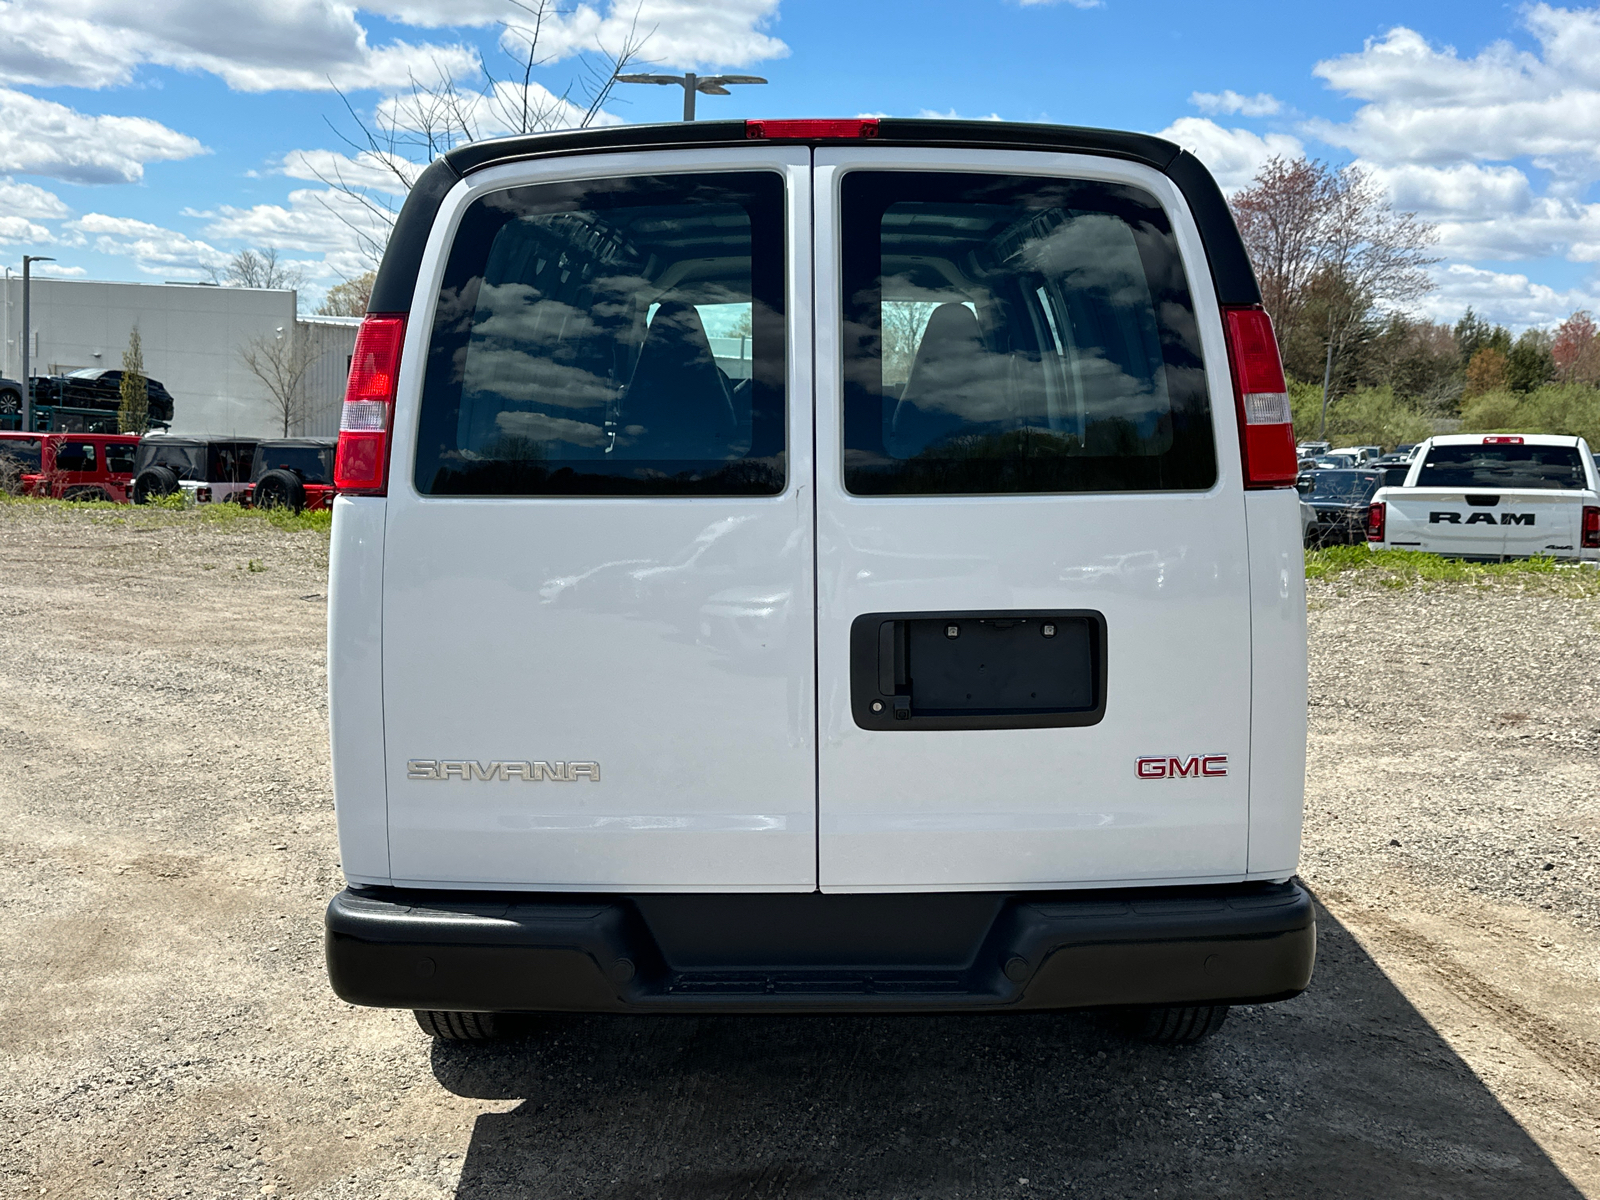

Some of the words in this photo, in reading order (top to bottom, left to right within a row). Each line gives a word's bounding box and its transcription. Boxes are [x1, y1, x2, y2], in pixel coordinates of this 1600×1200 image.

[1429, 511, 1536, 526] RAM
[407, 758, 601, 782] SAVANA
[1134, 753, 1229, 779] GMC
